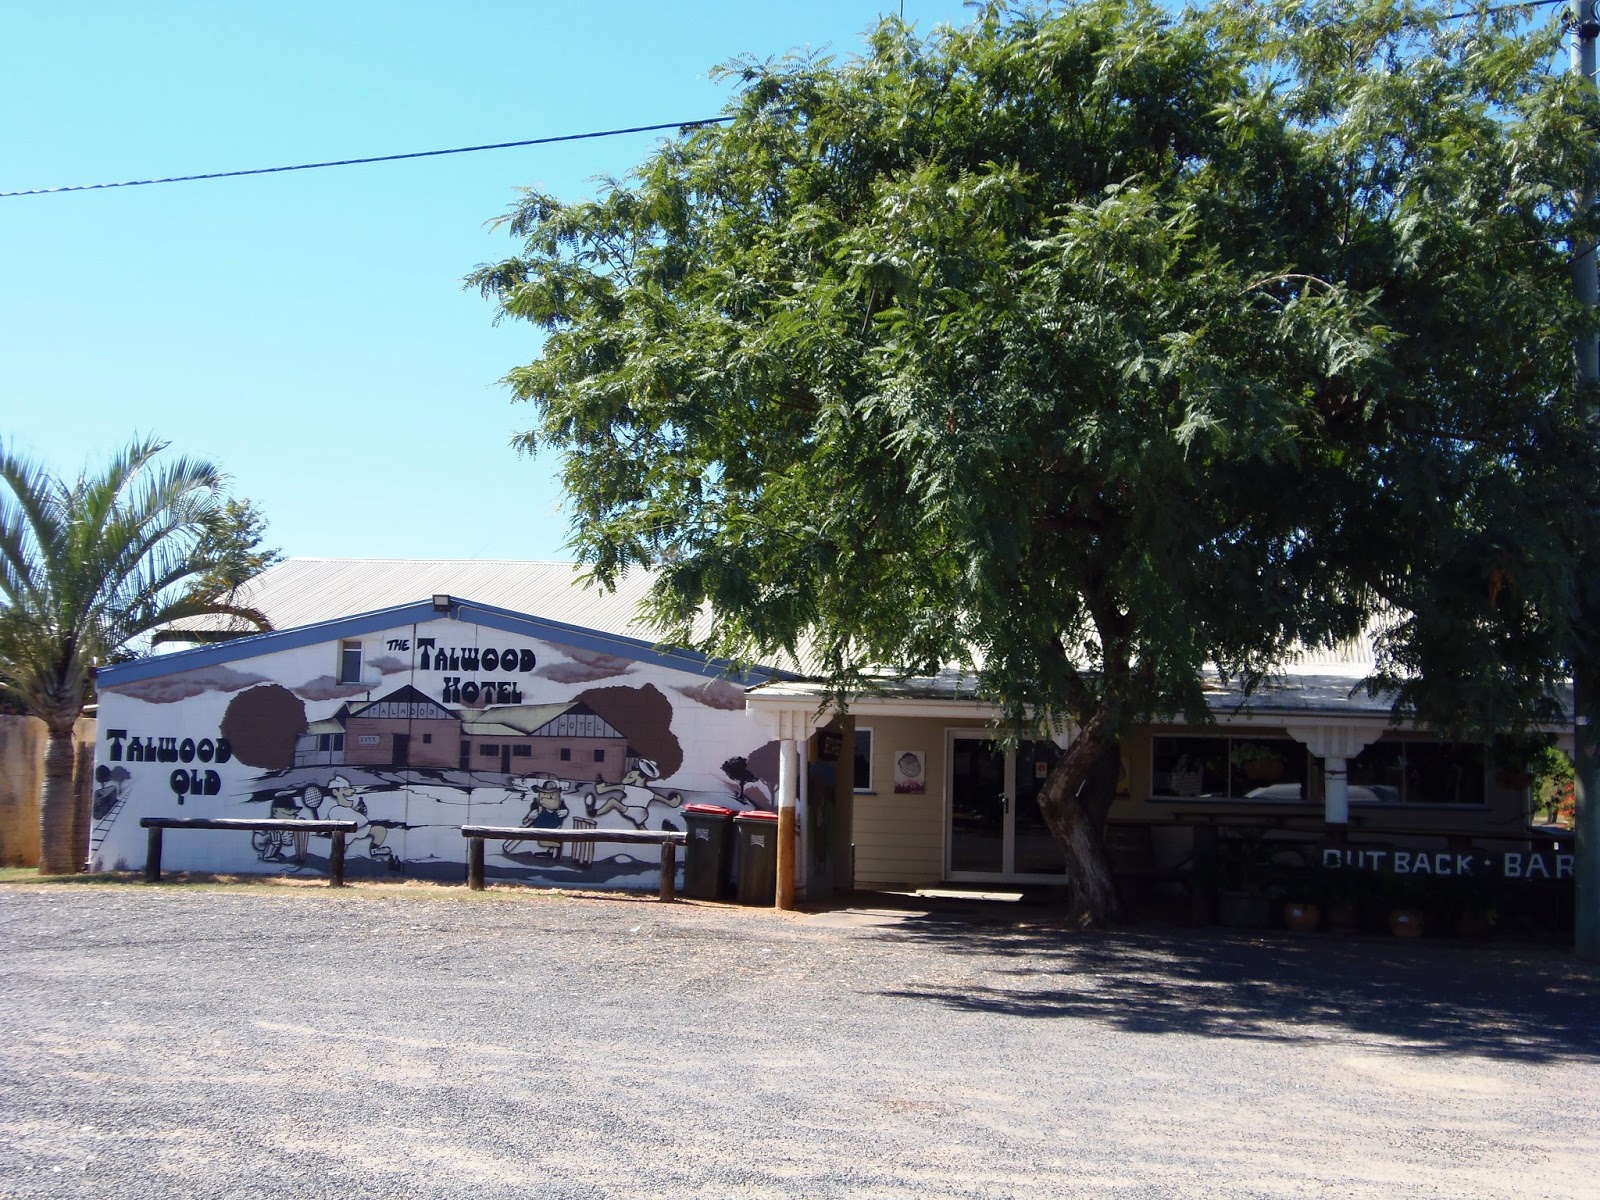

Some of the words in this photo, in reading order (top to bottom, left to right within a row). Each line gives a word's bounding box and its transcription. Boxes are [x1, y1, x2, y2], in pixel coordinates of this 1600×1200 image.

[386, 639, 410, 651] THE
[417, 637, 537, 672] TALWOOD
[442, 677, 522, 704] HOTEL
[561, 722, 601, 731] HOTEL
[106, 729, 232, 762] TALWOOD
[170, 769, 221, 805] QLD
[1504, 852, 1574, 879] BAR
